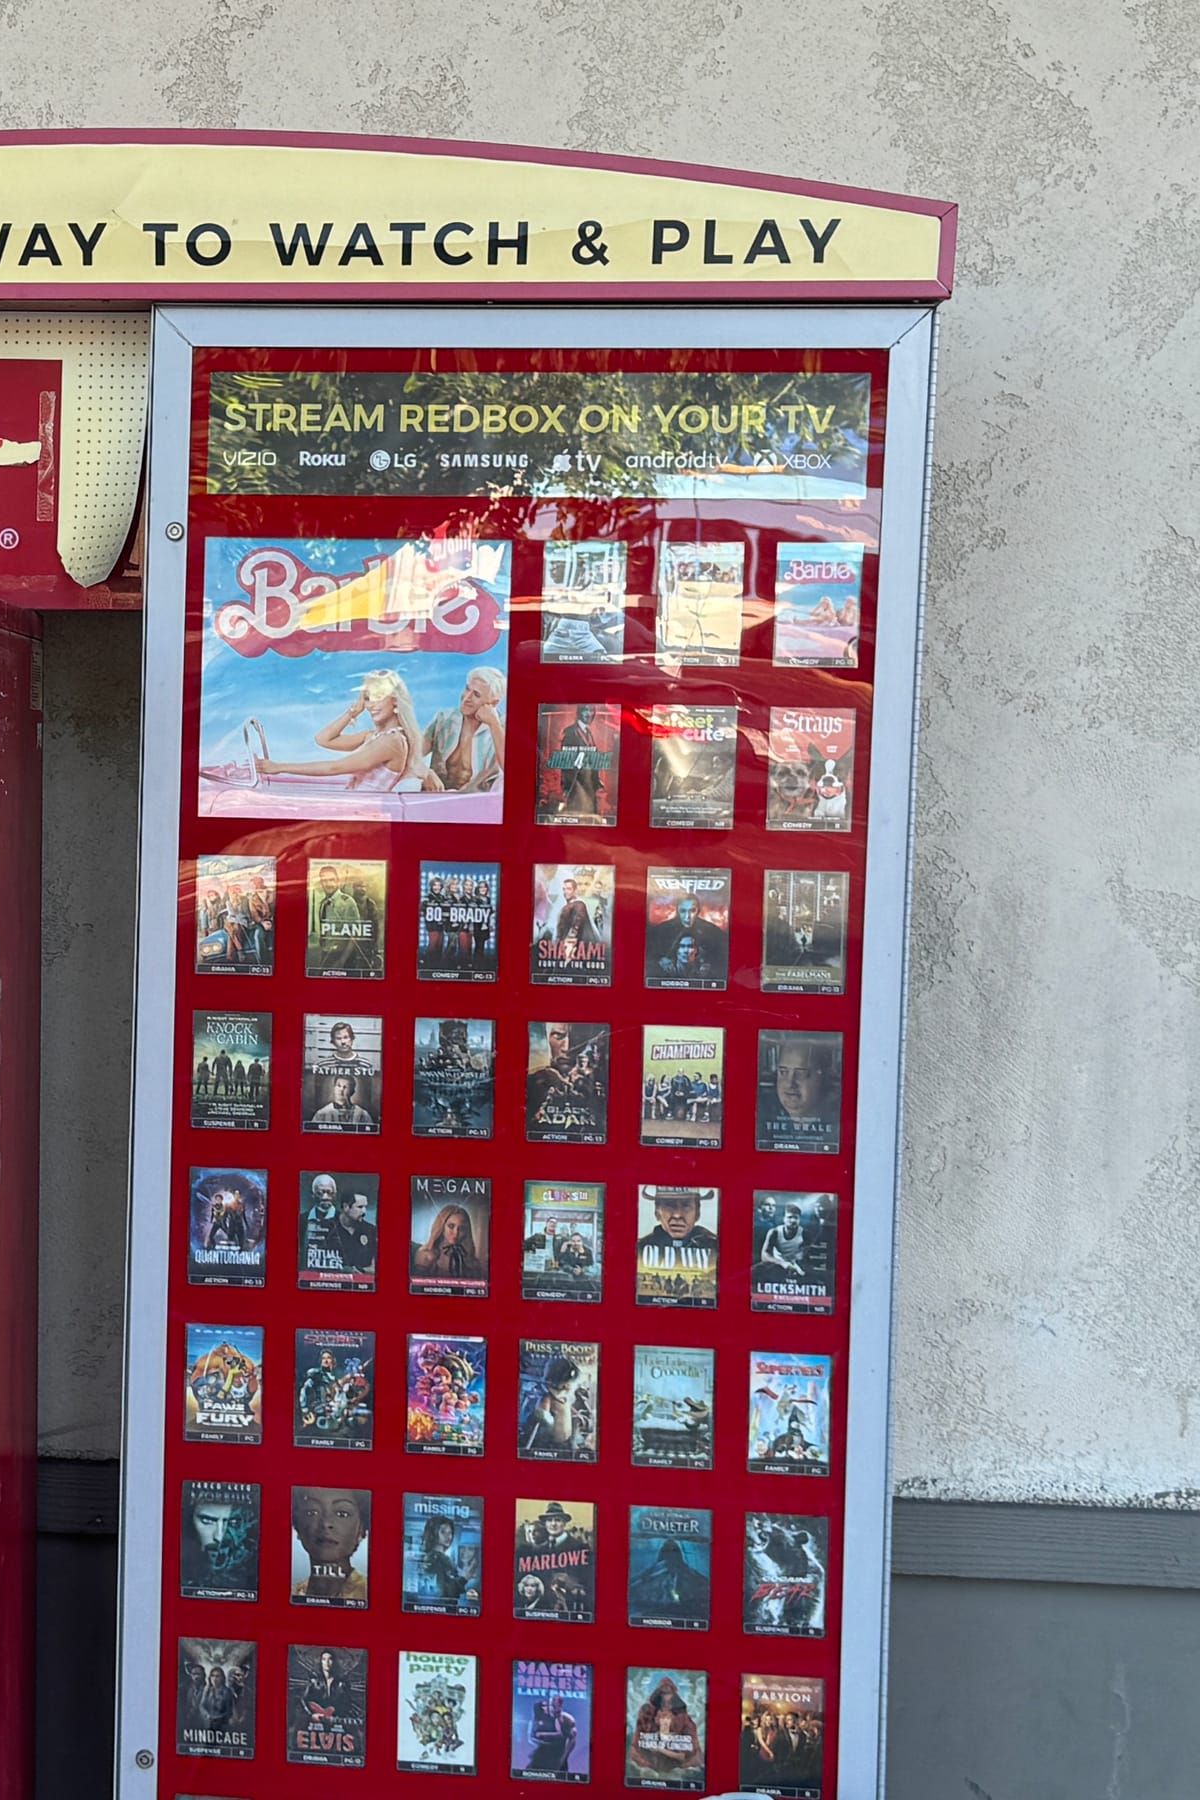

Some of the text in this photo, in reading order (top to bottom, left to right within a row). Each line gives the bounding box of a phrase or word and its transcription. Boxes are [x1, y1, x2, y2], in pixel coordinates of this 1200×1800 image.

[144, 222, 232, 267] TO
[271, 221, 529, 267] WATCH
[572, 220, 610, 265] &
[653, 217, 842, 264] PLAY
[224, 403, 835, 434] STREAM REDBOX ON YOUR TV
[223, 451, 277, 466] VIZIO
[394, 453, 417, 467] LG
[440, 453, 529, 467] SAMSUNG
[577, 451, 601, 472] tv
[783, 454, 832, 469] XBOX
[784, 560, 850, 581] Barbie
[217, 549, 481, 640] Barbie
[655, 878, 725, 894] RENFIELD
[425, 907, 491, 923] 80 BRADY
[321, 923, 373, 937] PLANE
[206, 1022, 253, 1034] KNOCK
[216, 1033, 258, 1045] CABIN
[652, 1044, 715, 1059] CHAMPIONS
[312, 1065, 375, 1077] FATHER STU
[308, 1248, 342, 1260] RITUAL
[642, 1245, 675, 1269] OLD
[307, 1258, 343, 1269] KILLER
[757, 1282, 826, 1296] LOCKSMITH
[196, 1412, 254, 1426] FURY
[414, 1502, 470, 1519] missing
[642, 1517, 699, 1533] DEMETER
[519, 1550, 589, 1572] MARLOWE
[313, 1565, 346, 1577] TILL
[405, 1652, 469, 1665] house
[408, 1662, 466, 1677] party
[517, 1661, 587, 1678] MAGIC
[753, 1691, 811, 1702] BABYLON
[184, 1729, 248, 1745] MINDCAGE
[297, 1730, 354, 1752] ELVIS
